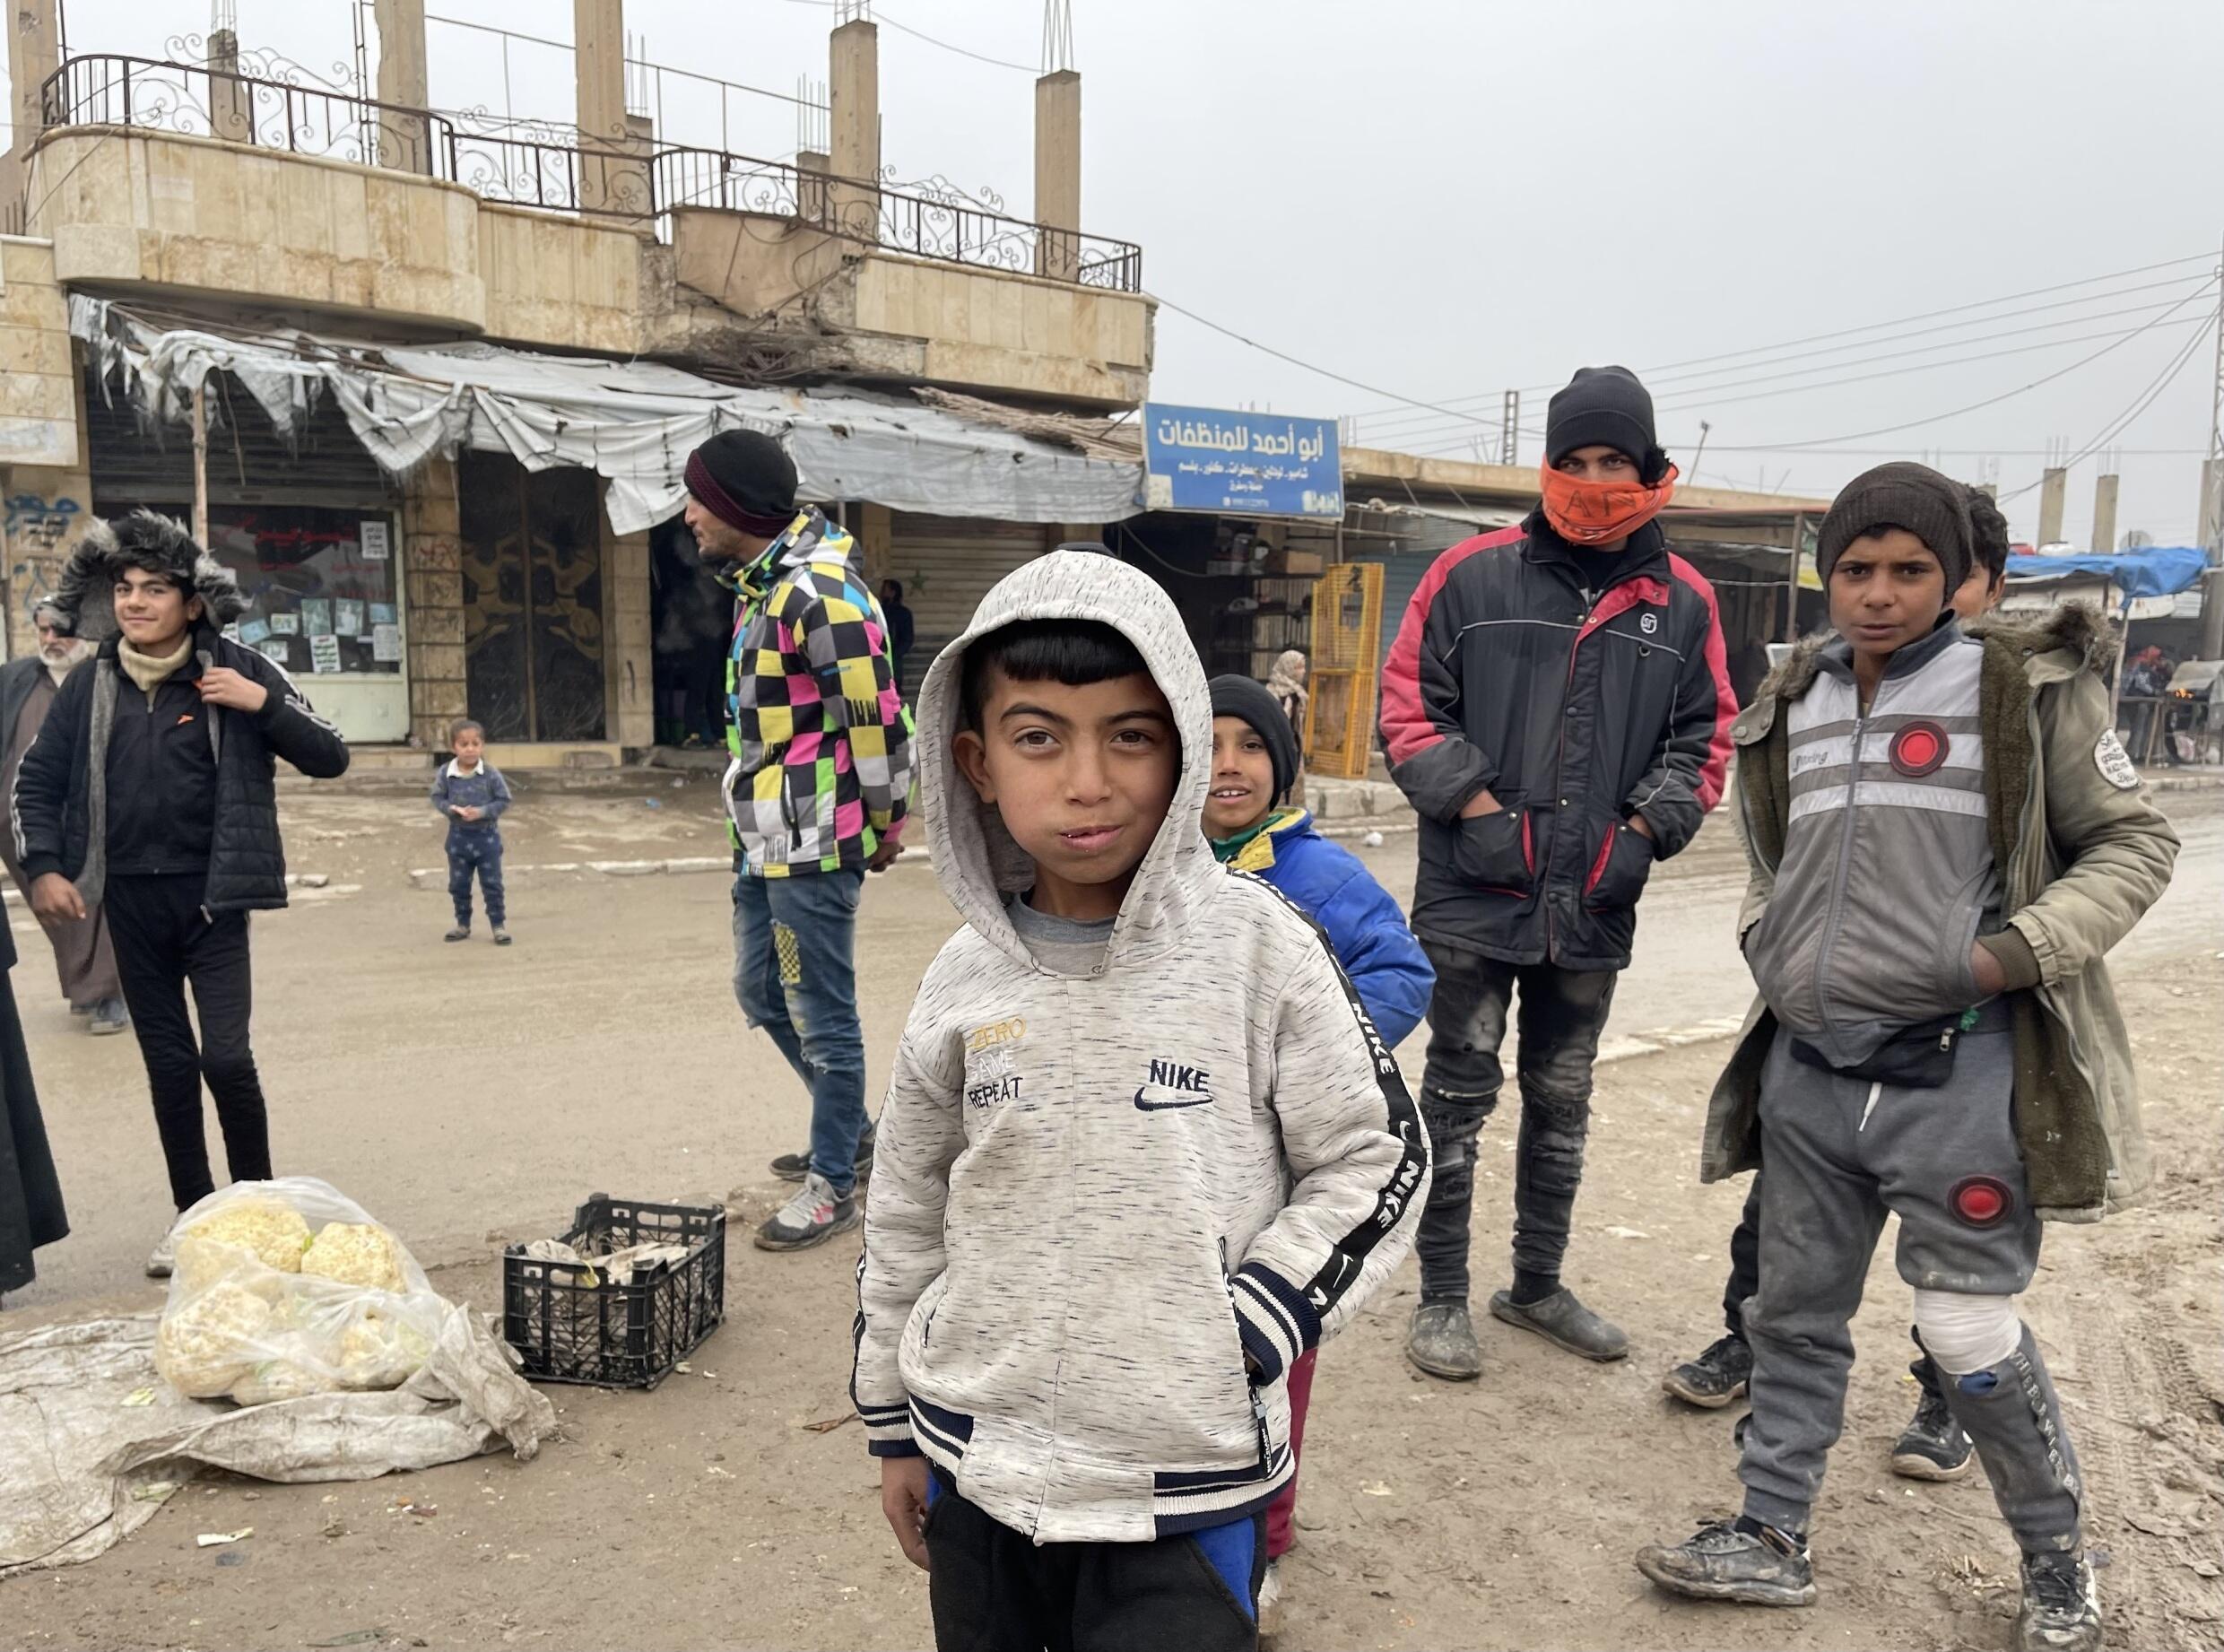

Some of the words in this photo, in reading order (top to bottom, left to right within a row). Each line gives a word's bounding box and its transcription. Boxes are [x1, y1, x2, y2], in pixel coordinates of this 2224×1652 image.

[1158, 420, 1248, 452] للمنظفات
[1252, 423, 1295, 456] أحمد
[1298, 425, 1324, 463] أبو
[969, 1017, 1027, 1050] ZERO
[966, 1049, 1017, 1082] GAME
[1149, 1058, 1211, 1092] NIKE
[967, 1076, 1024, 1110] REPEAT
[1377, 1160, 1420, 1230] NIKE
